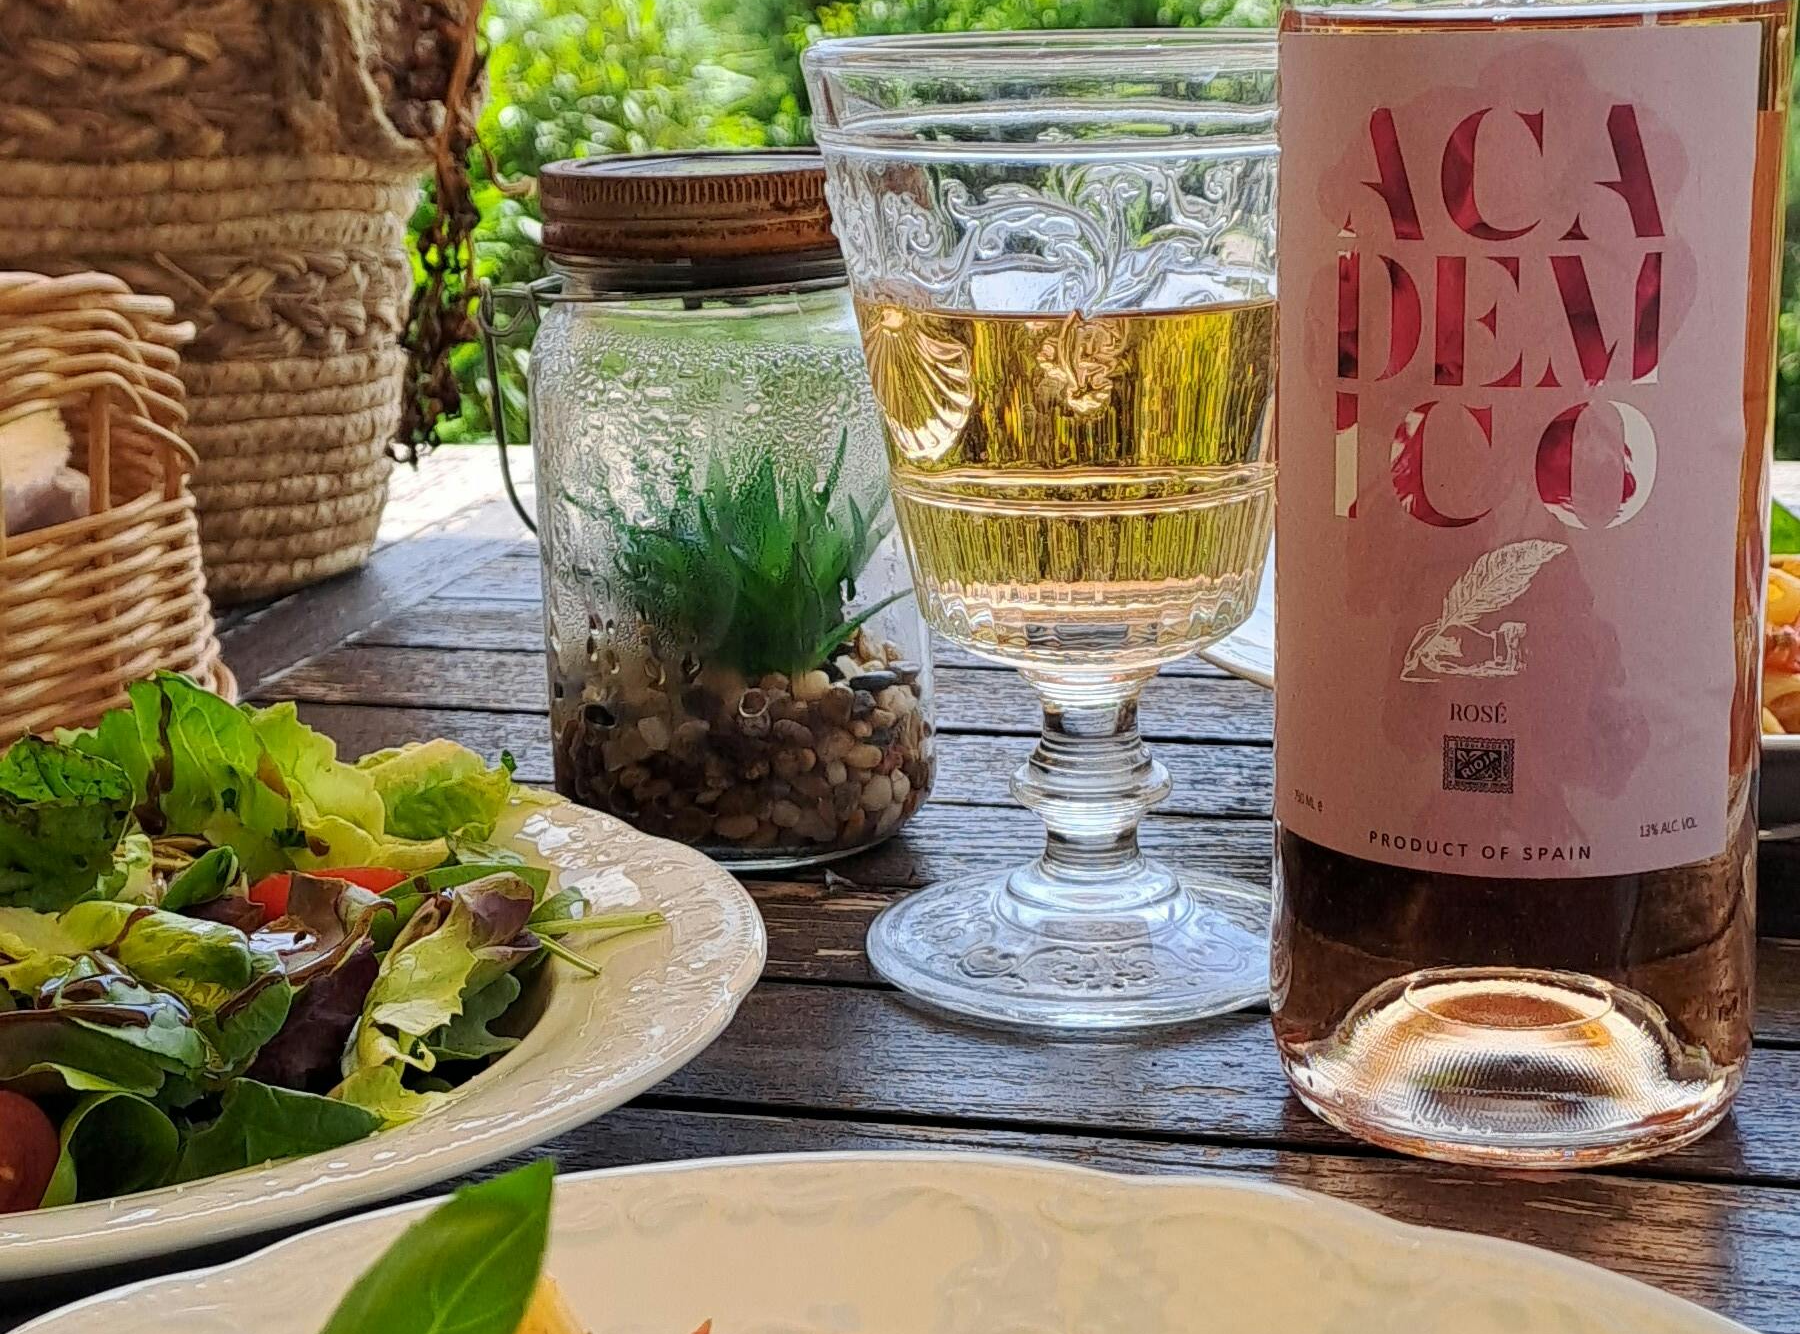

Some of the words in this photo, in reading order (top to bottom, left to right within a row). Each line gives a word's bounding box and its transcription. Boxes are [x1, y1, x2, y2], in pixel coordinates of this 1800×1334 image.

[1337, 104, 1665, 241] ACA
[1337, 251, 1663, 388] DEM
[1335, 391, 1658, 530] ICO
[1450, 701, 1507, 723] ROSÉ
[1461, 750, 1499, 778] RIOJA
[1369, 830, 1468, 857] PRODUCT
[1481, 846, 1508, 860] OF
[1523, 846, 1591, 861] SPAIN
[1639, 823, 1658, 838] 13%
